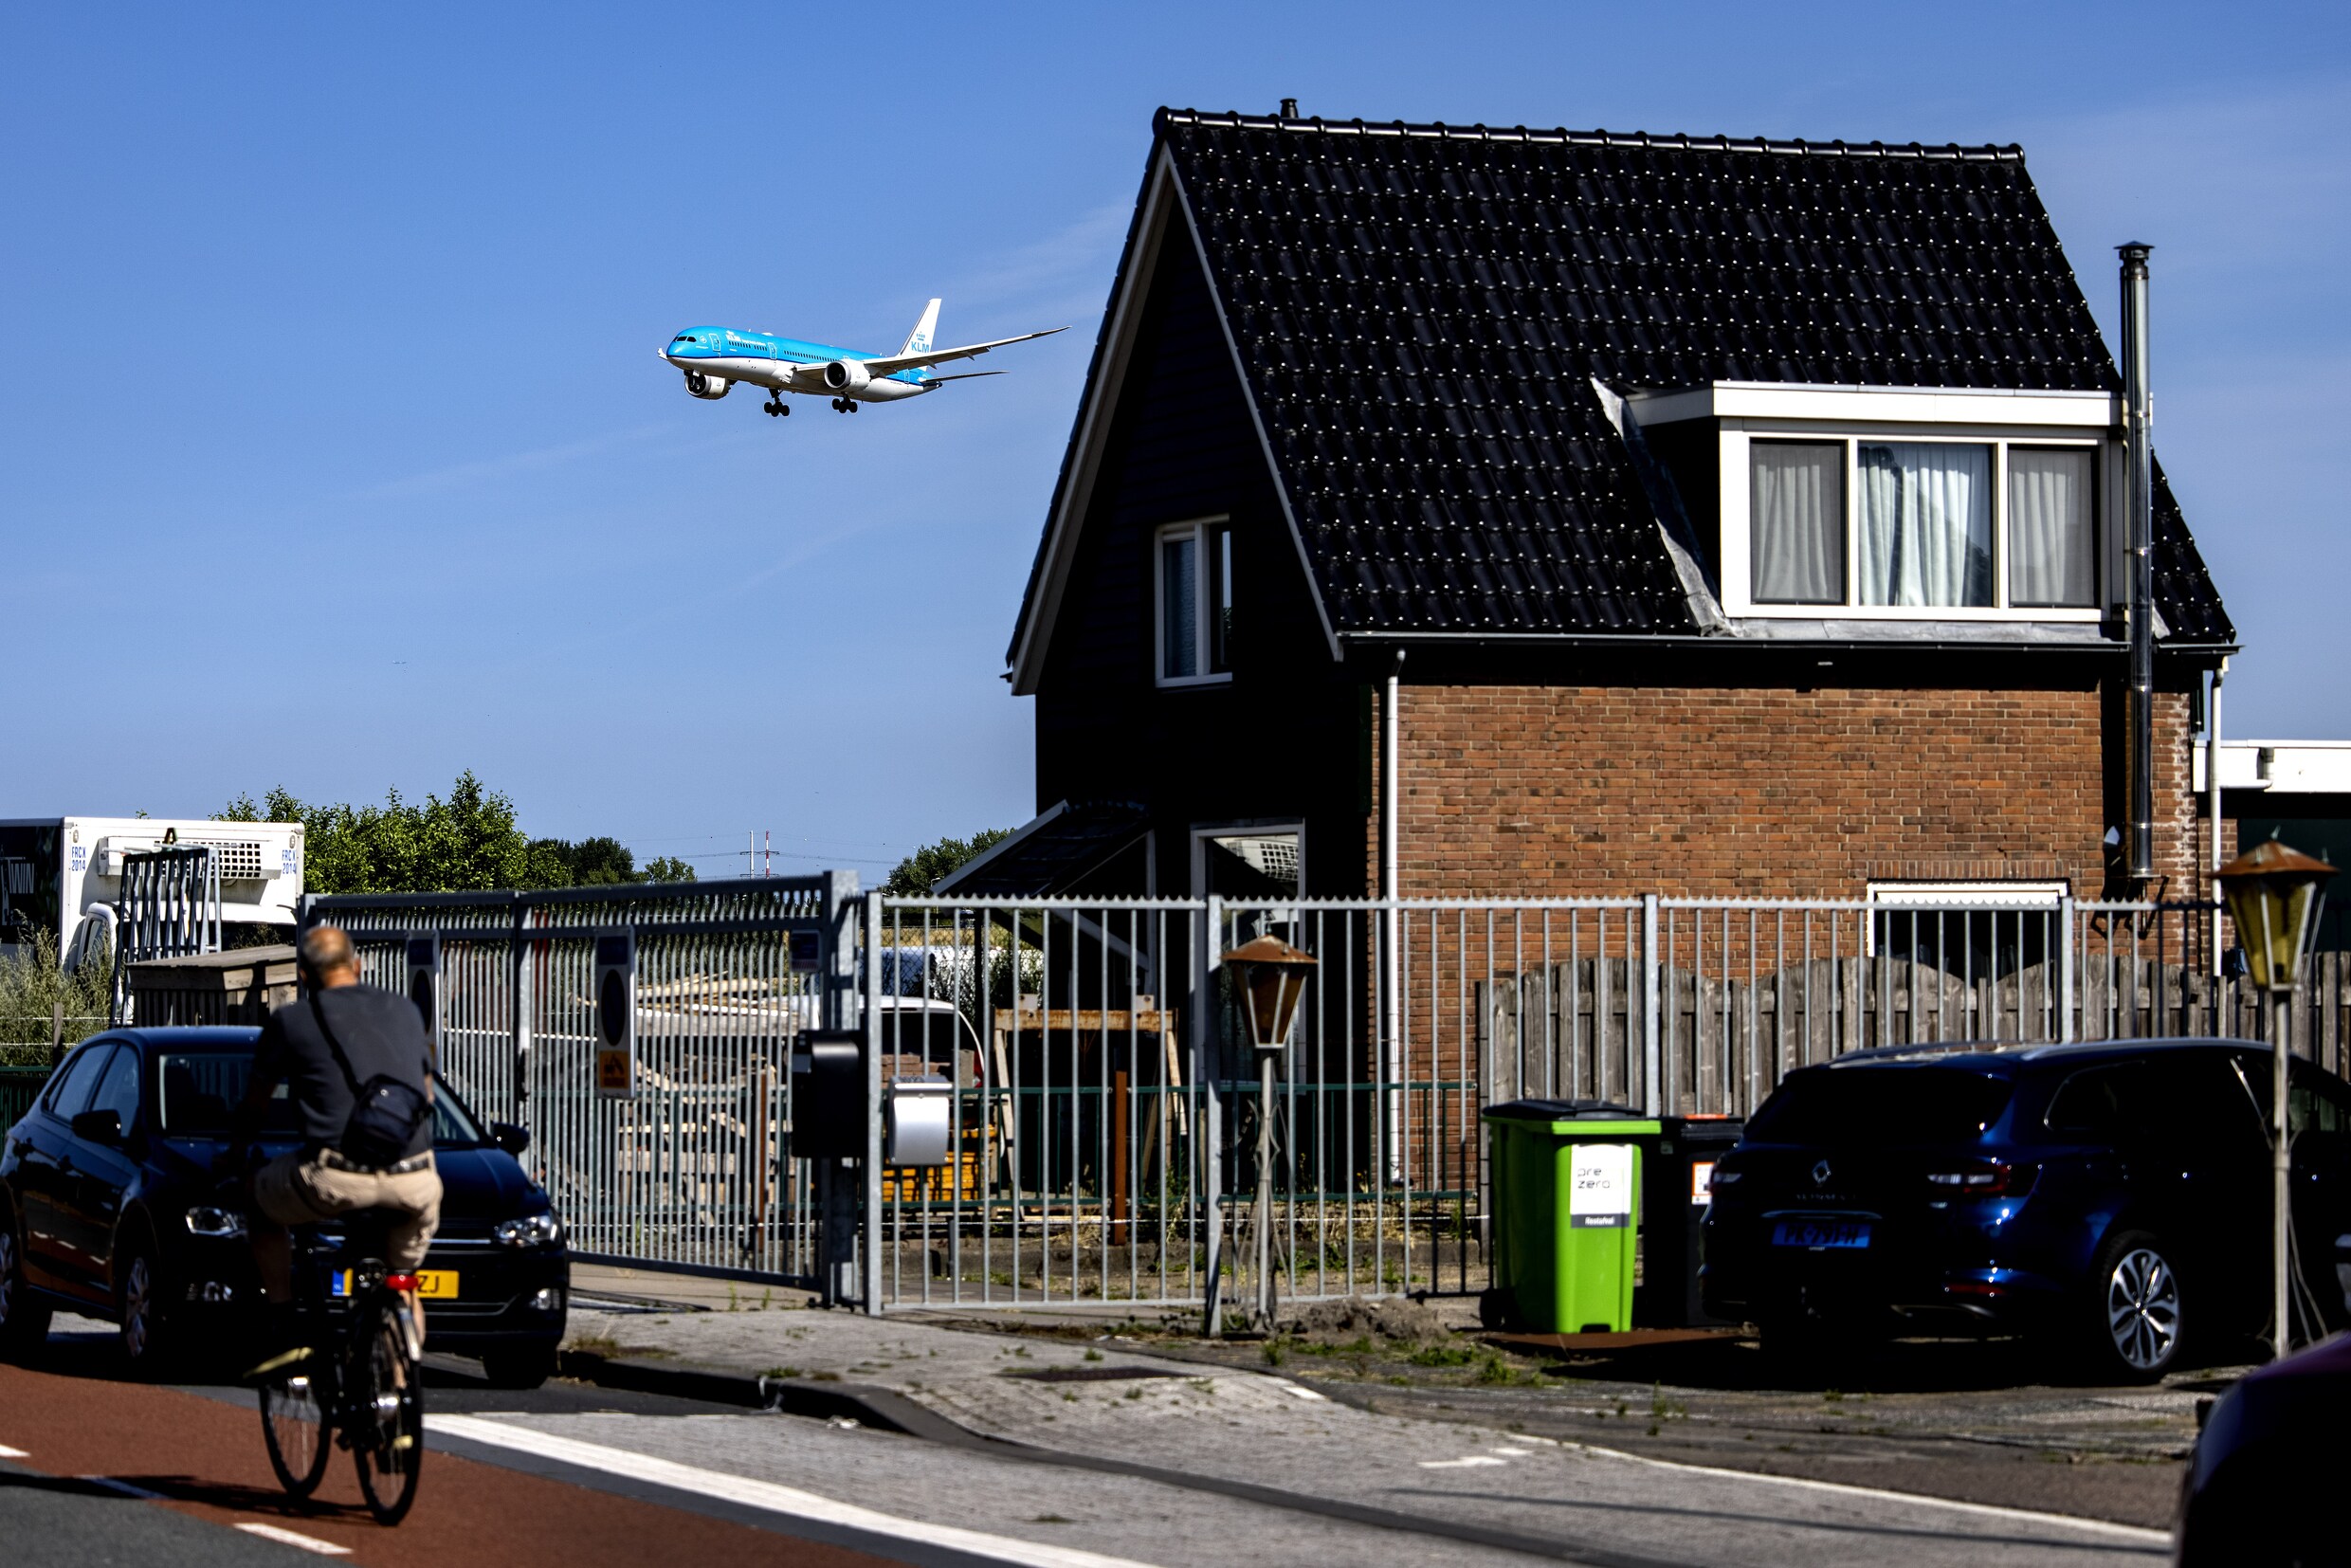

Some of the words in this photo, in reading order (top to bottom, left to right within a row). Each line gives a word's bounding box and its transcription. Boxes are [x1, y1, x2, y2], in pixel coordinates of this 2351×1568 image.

[911, 341, 930, 354] KLM
[71, 846, 86, 859] FRCX
[71, 859, 86, 871] 2014
[282, 862, 297, 874] 2014
[1577, 1179, 1611, 1190] zero
